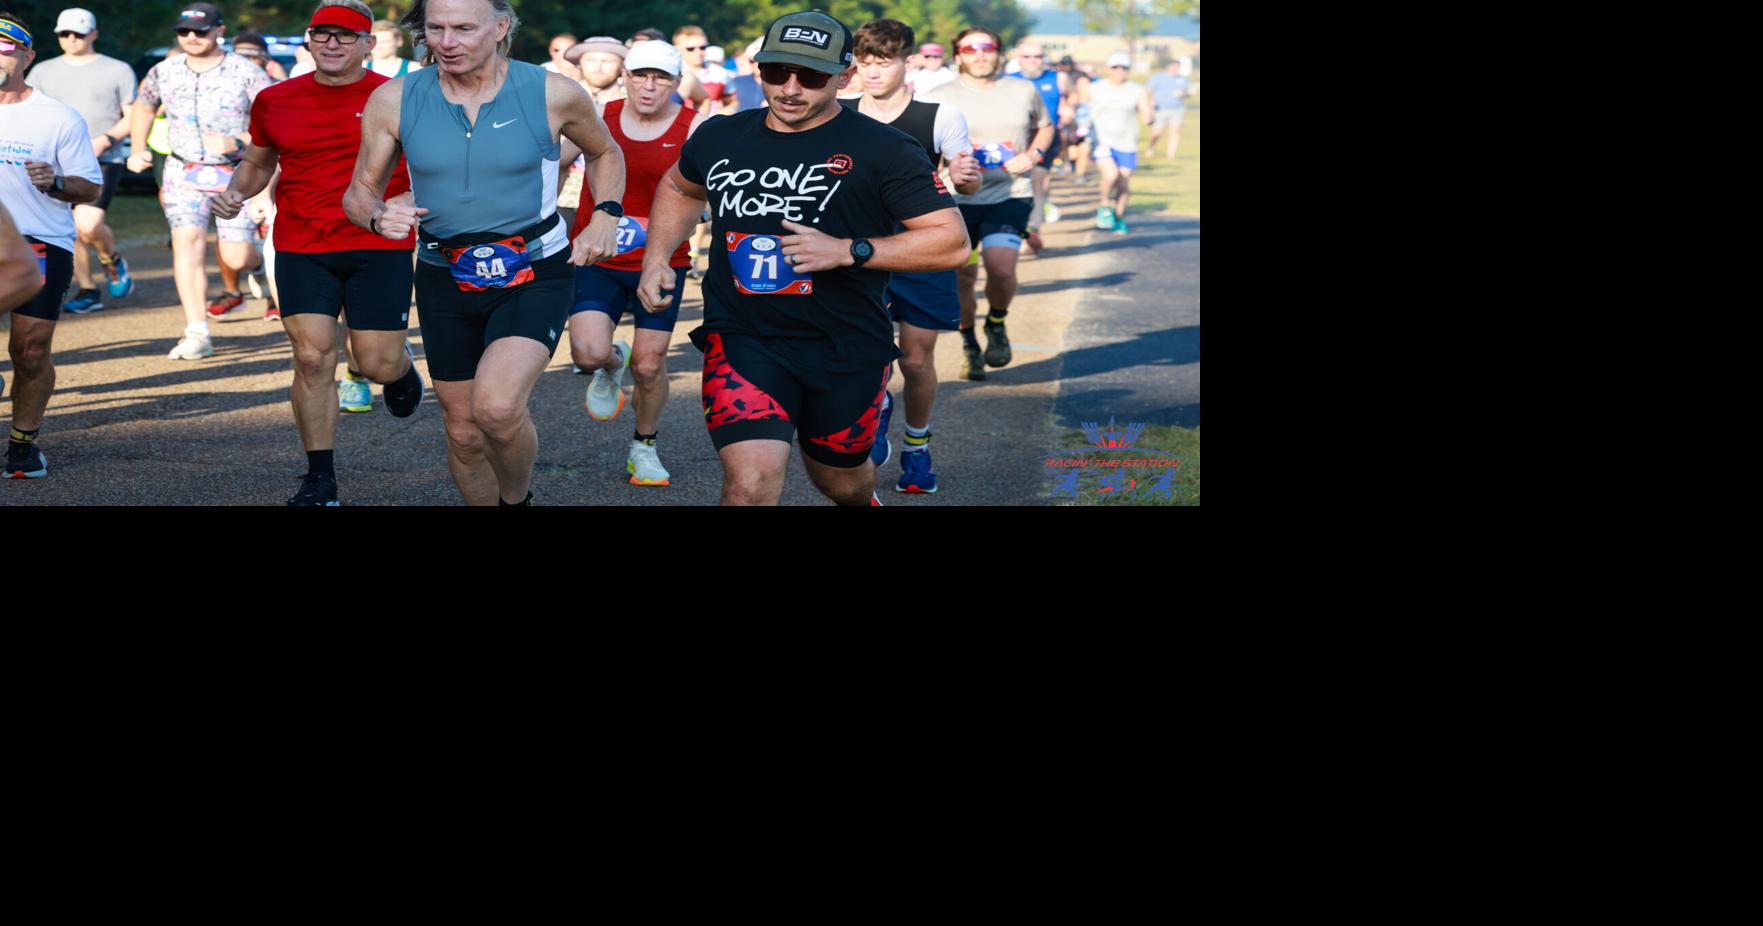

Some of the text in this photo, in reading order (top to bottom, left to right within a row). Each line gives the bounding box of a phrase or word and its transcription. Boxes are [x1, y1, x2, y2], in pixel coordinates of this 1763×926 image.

[706, 158, 756, 192] GO
[759, 163, 843, 195] ONE
[718, 180, 842, 223] MORE!
[616, 227, 636, 246] 27
[475, 257, 508, 279] 44
[748, 253, 778, 280] 71
